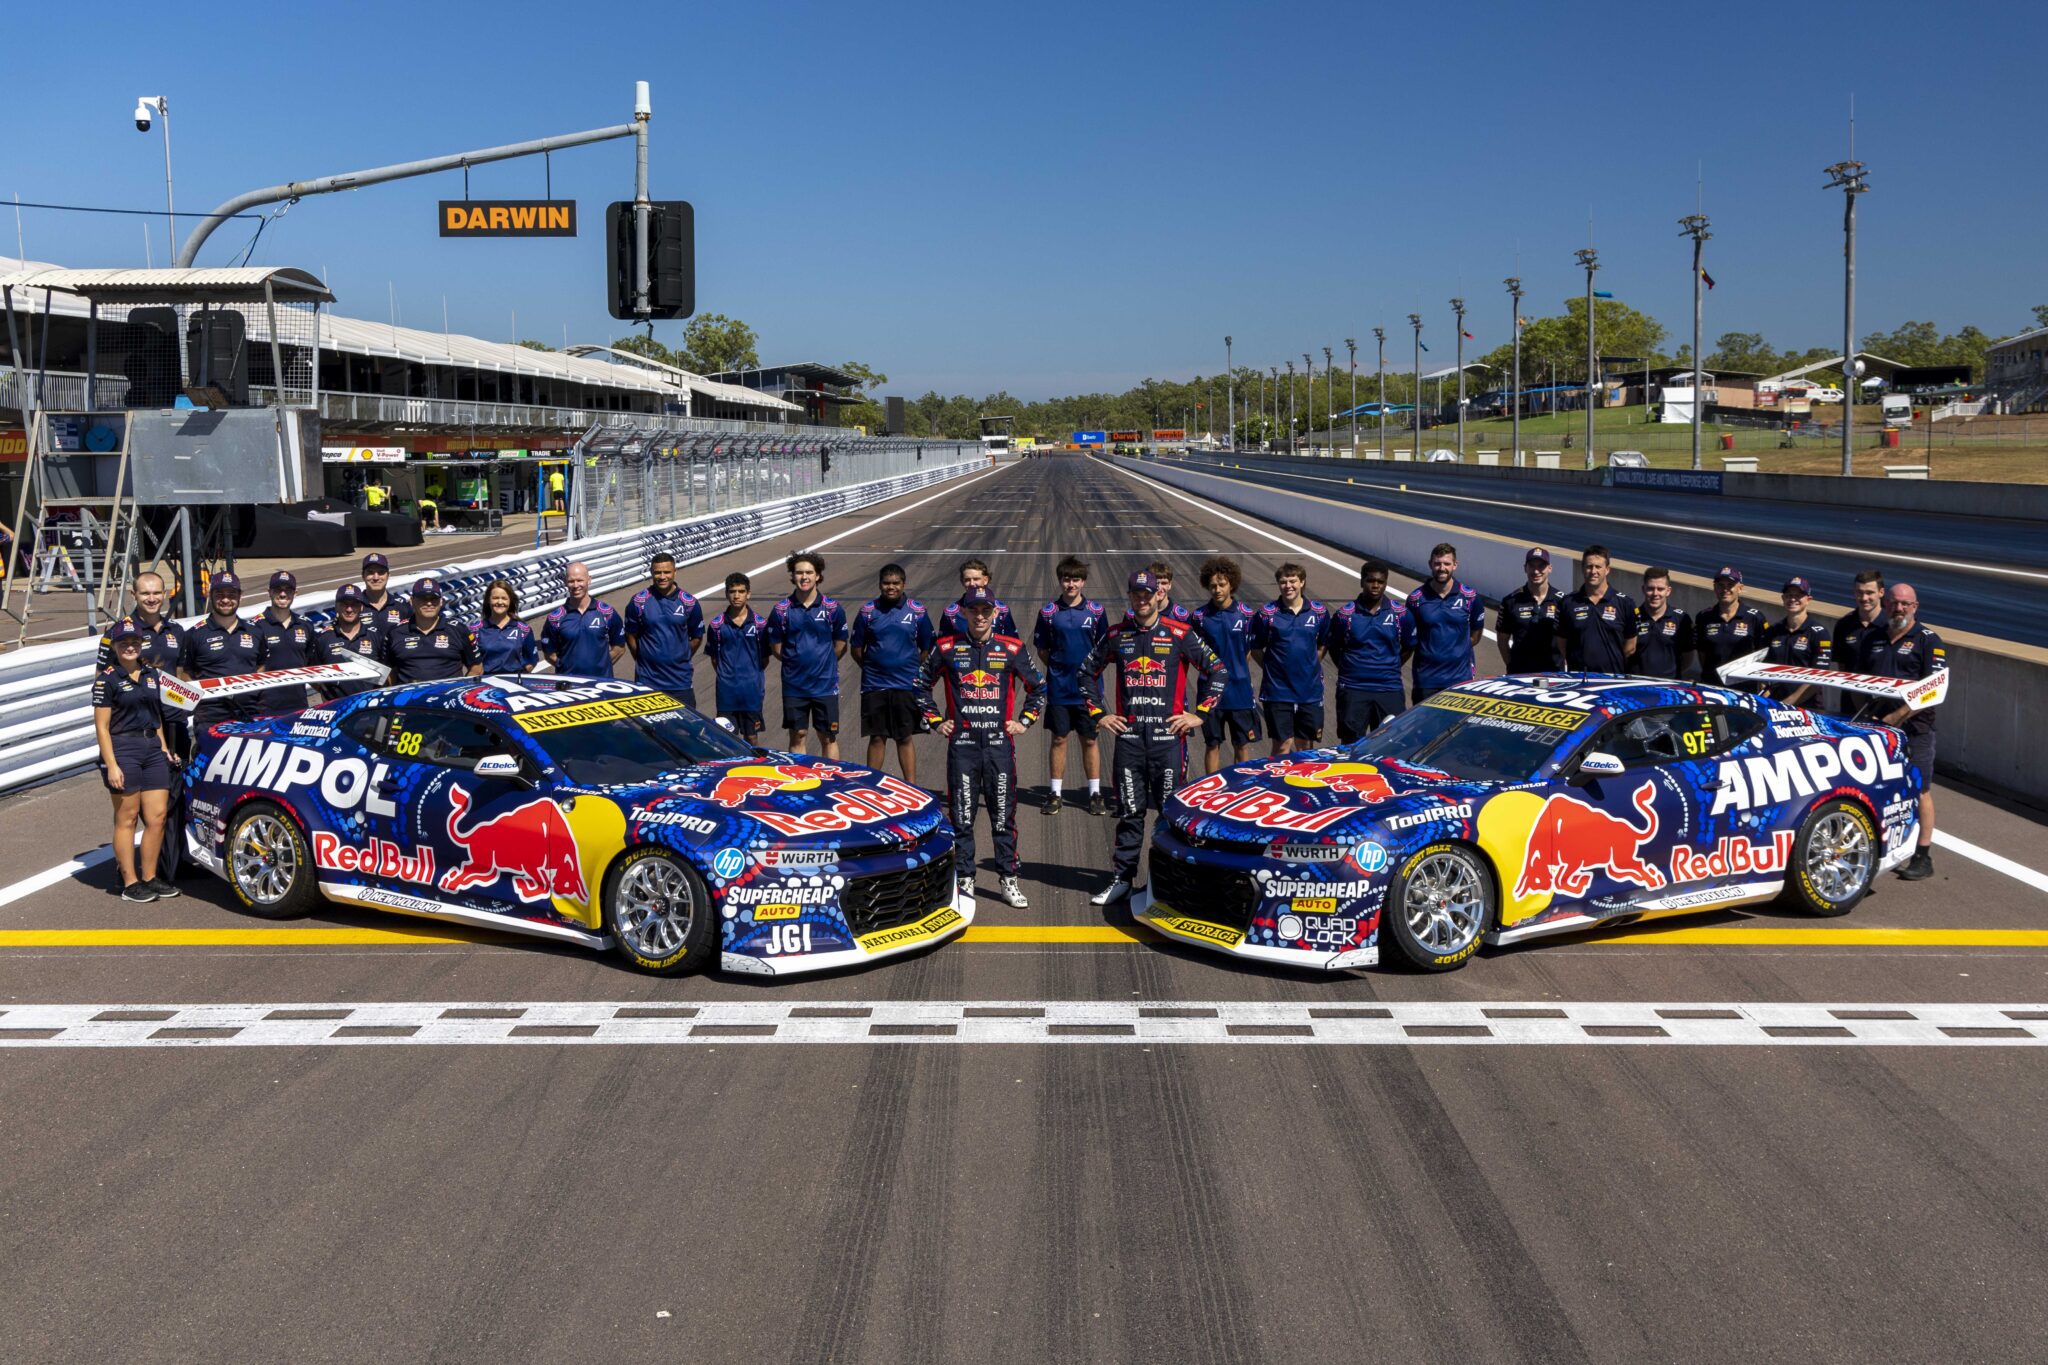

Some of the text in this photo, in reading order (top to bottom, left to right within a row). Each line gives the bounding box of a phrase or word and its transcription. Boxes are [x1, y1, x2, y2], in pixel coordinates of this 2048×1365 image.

[446, 206, 570, 230] DARWIN
[207, 669, 361, 695] Premium Fuels
[225, 663, 344, 685] AMPLIFY
[1125, 675, 1166, 688] Red Bull
[1749, 669, 1898, 695] Premium Fuels
[1789, 666, 1919, 688] AMPLIFY
[159, 675, 201, 702] SUPERCHEAP
[168, 691, 184, 703] AUTO
[504, 680, 654, 712] AMPOL
[960, 687, 1000, 700] Red Bull
[1451, 679, 1601, 710] AMPOL
[1906, 673, 1946, 701] SUPERCHEAP
[299, 707, 337, 724] Harvey
[519, 694, 679, 731] NATIONAL STORAGE
[640, 710, 684, 725] Feeney
[961, 705, 1000, 714] AMPOL
[1488, 701, 1582, 727] STORAGE
[1768, 708, 1806, 725] Harvey
[288, 721, 332, 738] Norman
[1480, 716, 1536, 733] Gisbergen
[1774, 724, 1815, 740] Norman
[396, 731, 423, 756] 88
[1682, 730, 1706, 755] 97
[479, 761, 518, 770] ACDelco
[1582, 759, 1619, 770] ACDelco
[1710, 733, 1904, 816] AMPOL
[203, 736, 396, 818] AMPOL
[997, 772, 1007, 794] GIVES
[1508, 781, 1549, 792] DUNLOP
[561, 786, 603, 796] DUNLOP
[962, 781, 972, 825] AMPLIFY
[1174, 773, 1264, 814] Red
[1220, 790, 1366, 833] Bull
[196, 799, 222, 817] AMPLIFY
[739, 774, 934, 837] Red Bull
[1385, 803, 1473, 831] ToolPRO
[1839, 803, 1862, 819] SPORT
[628, 806, 718, 836] ToolPRO
[312, 830, 436, 886] Red Bull
[624, 848, 672, 866] DUNLOP
[717, 848, 743, 879] hp
[1358, 842, 1386, 873] hp
[1402, 844, 1452, 880] SPORT MAXX
[1670, 829, 1796, 884] Red Bull
[370, 889, 442, 913] NEW HOLLAND
[726, 885, 836, 906] SUPERCHEAP
[1264, 879, 1370, 900] SUPERCHEAP
[1677, 886, 1746, 907] NEW HOLLAND
[1800, 871, 1832, 910] DUNLOP
[759, 905, 796, 917] AUTO
[1295, 899, 1331, 910] AUTO
[860, 908, 961, 950] NATIONAL STORAGE
[1179, 921, 1240, 943] STORAGE
[1304, 915, 1357, 934] QUAD
[765, 923, 811, 955] JGI
[1304, 929, 1357, 946] LOCK
[1434, 935, 1481, 964] DUNLOP
[635, 945, 688, 969] SPORT MAXX
